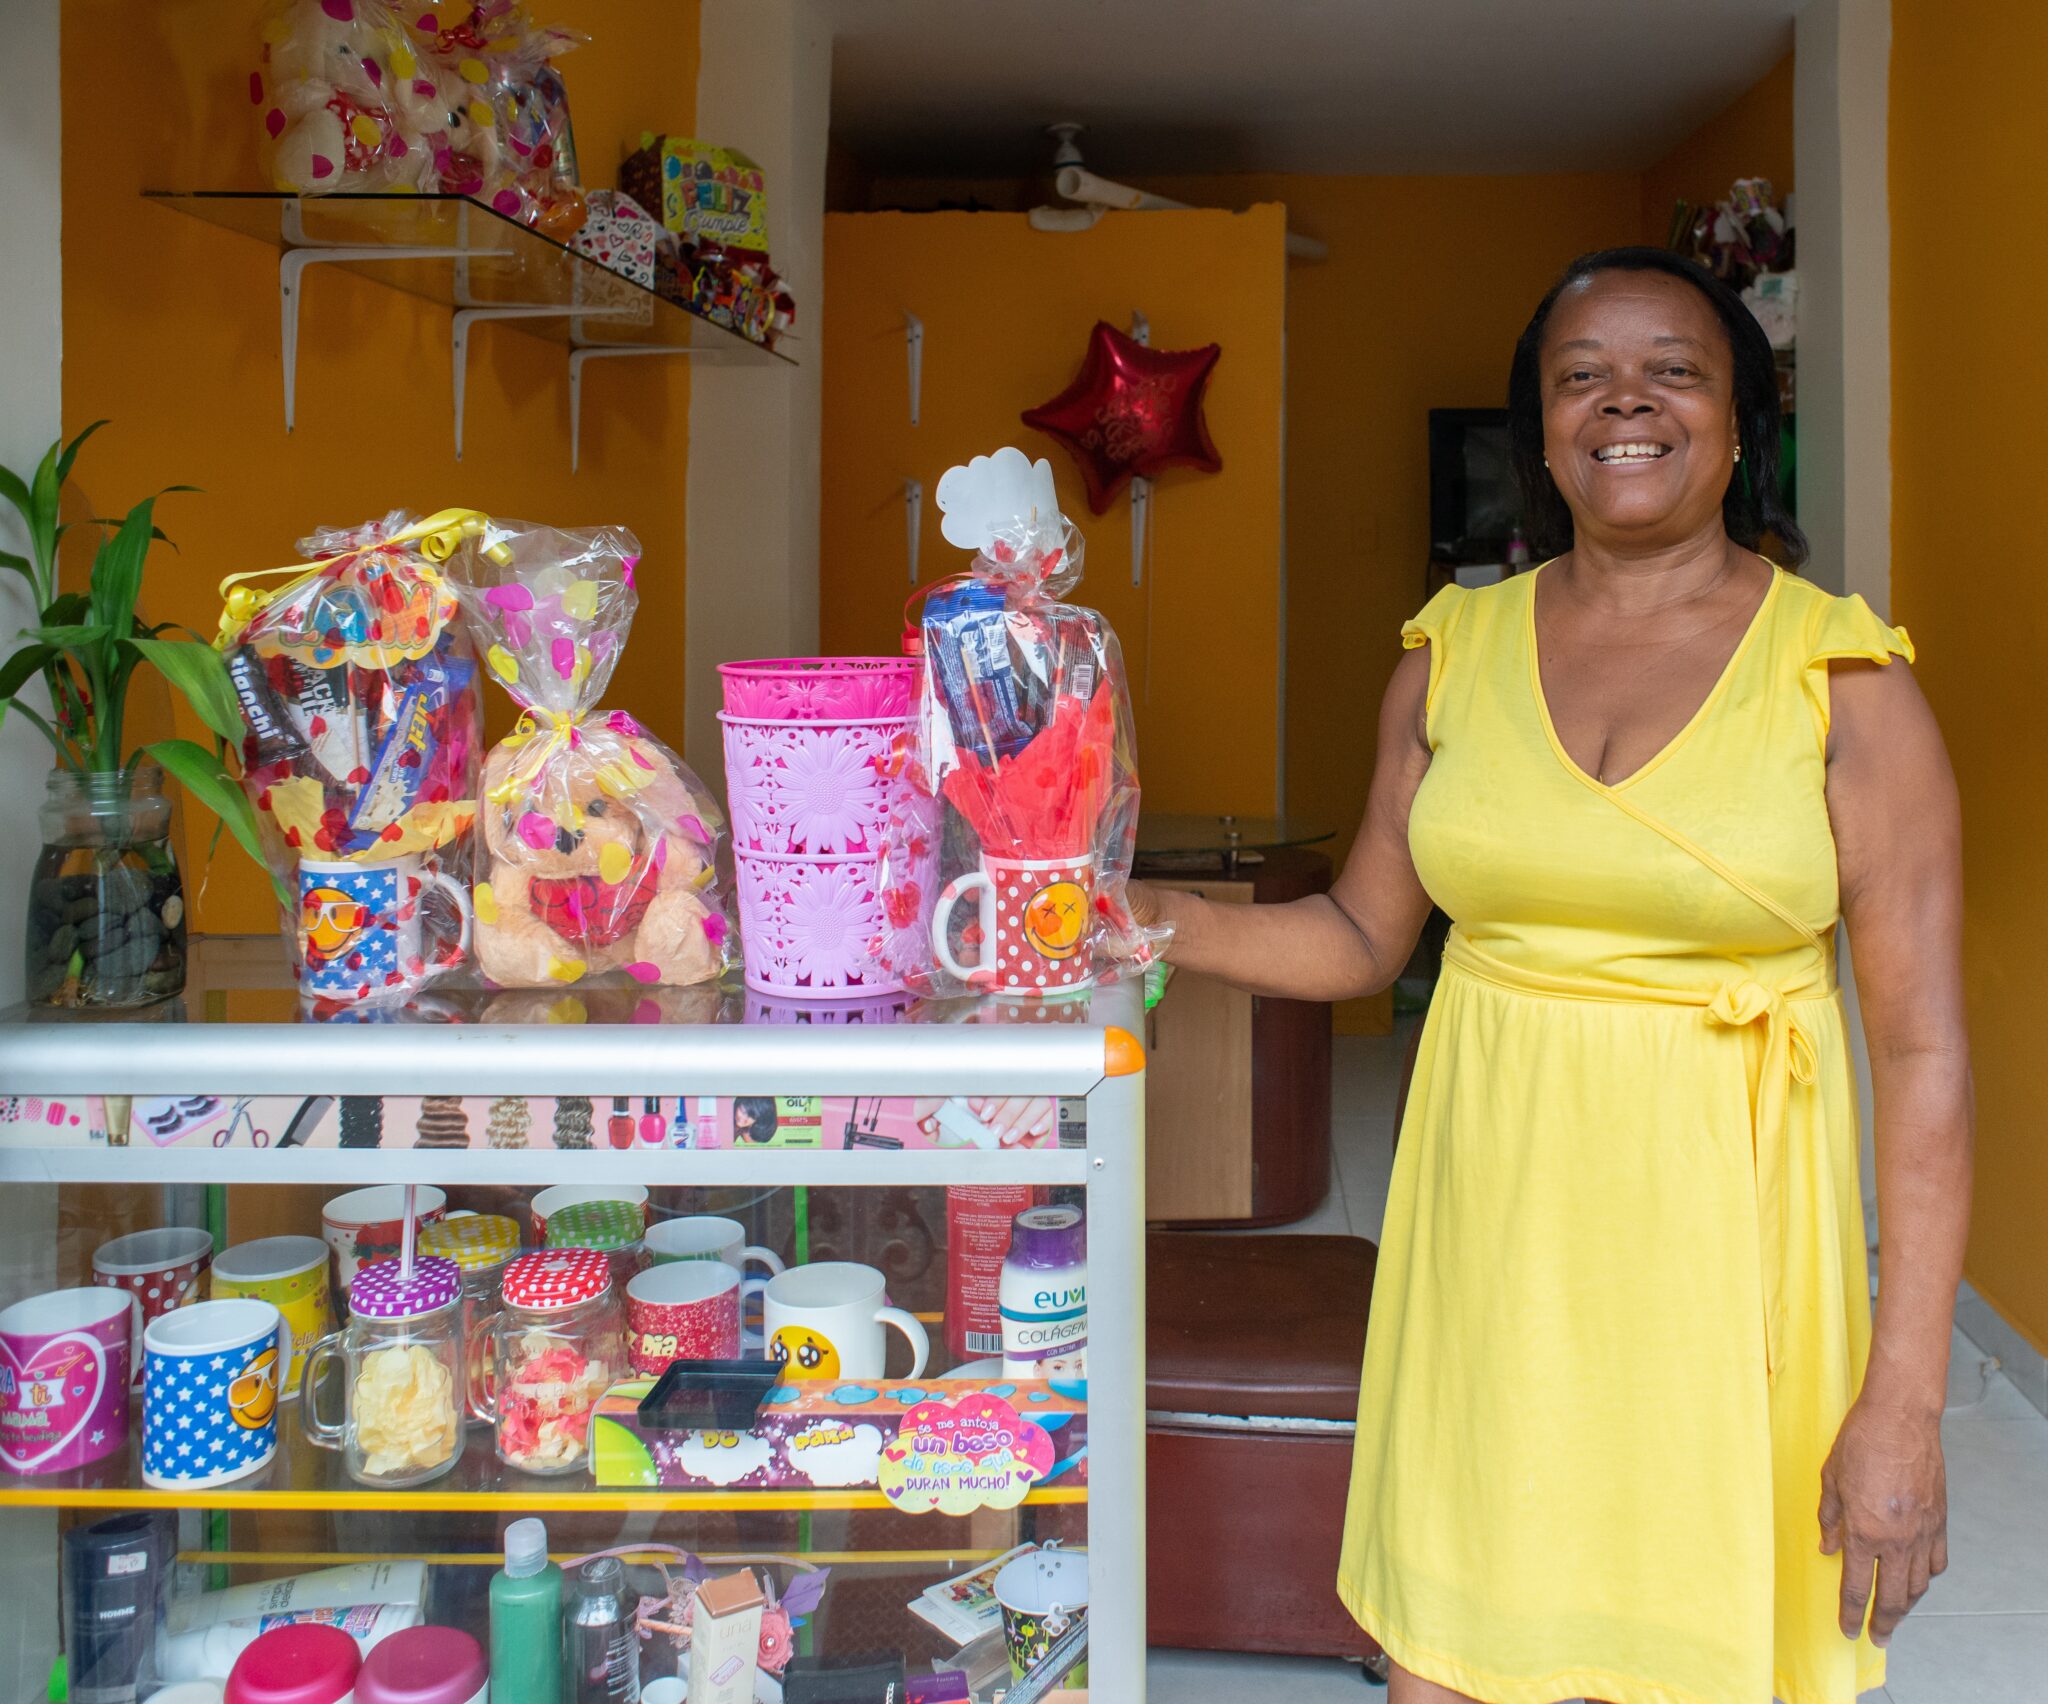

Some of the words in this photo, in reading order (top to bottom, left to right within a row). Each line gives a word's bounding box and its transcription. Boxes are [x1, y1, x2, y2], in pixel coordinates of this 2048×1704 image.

[681, 180, 752, 215] FELIZ
[30, 1383, 52, 1405] ti
[917, 1424, 932, 1434] se
[936, 1419, 955, 1429] me
[960, 1417, 999, 1431] antoja
[912, 1436, 948, 1455] un
[951, 1429, 1013, 1455] beso
[906, 1477, 950, 1490] DURAN
[959, 1471, 1011, 1490] MUCHO!
[99, 1605, 137, 1620] HOMME
